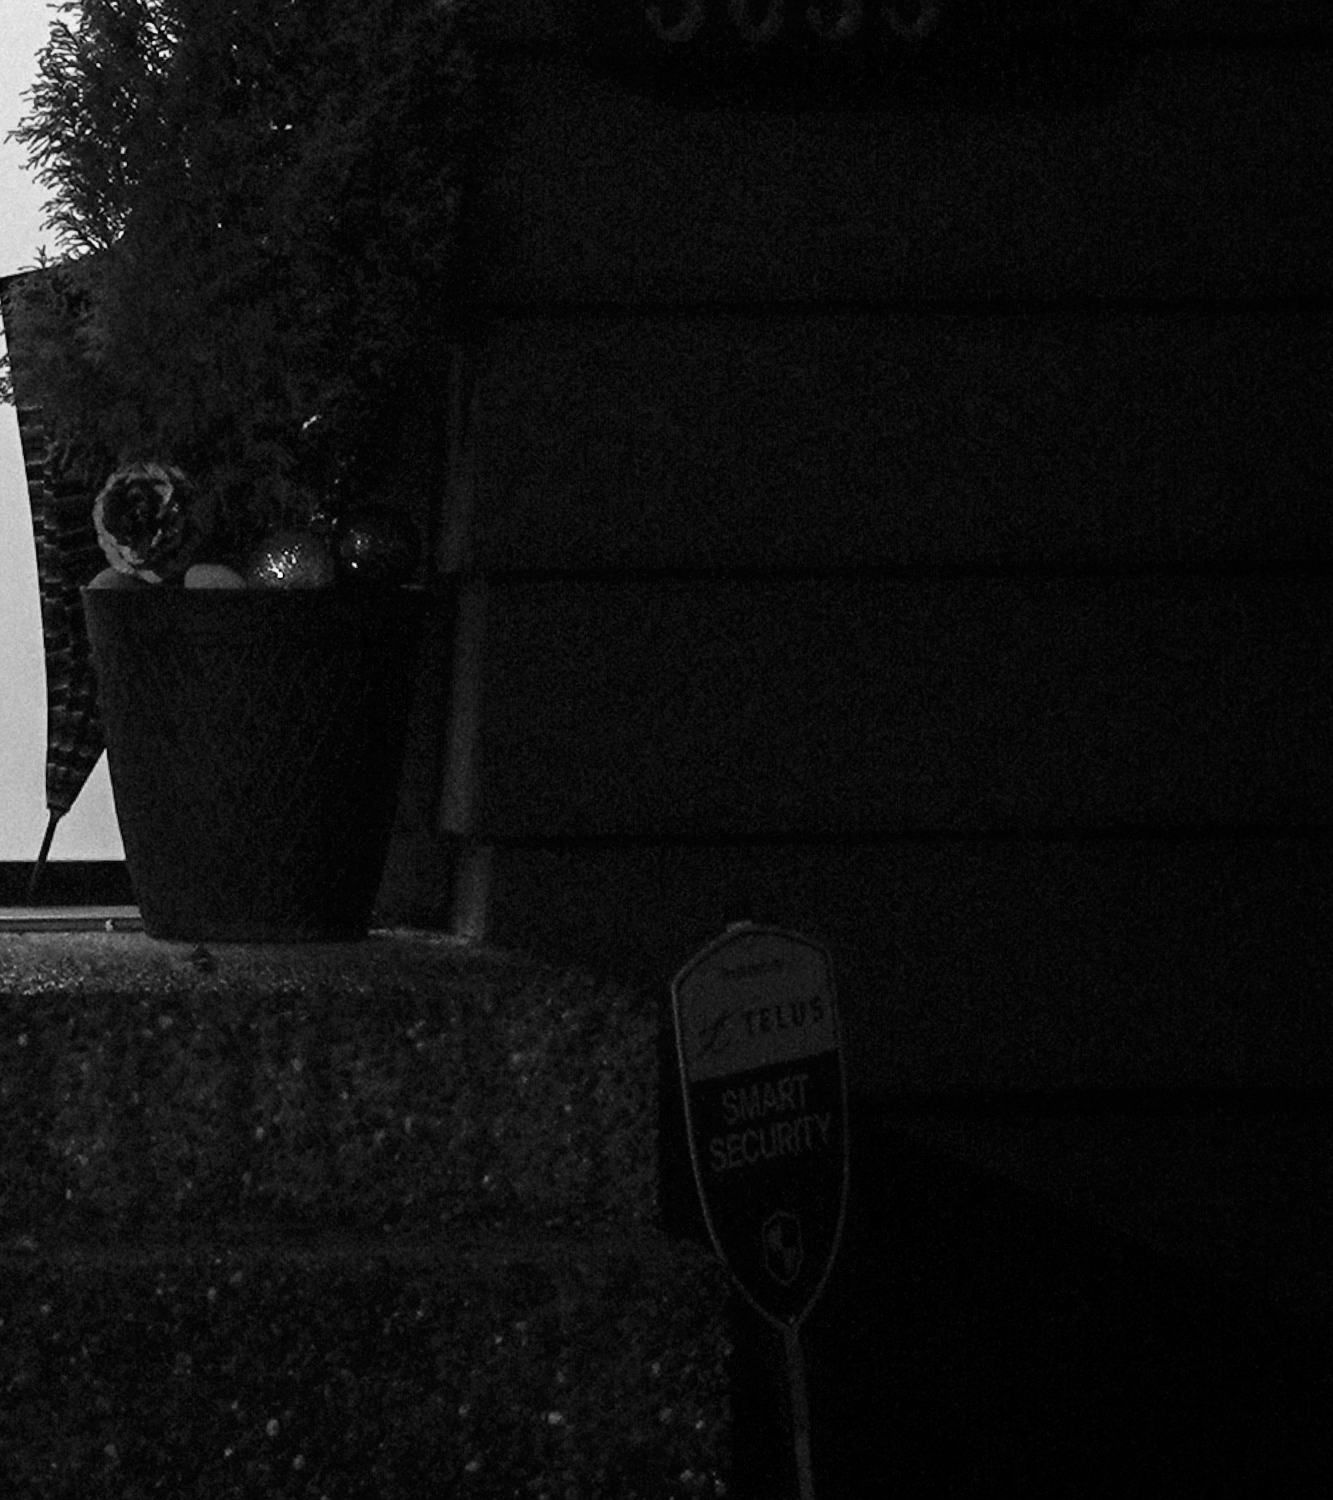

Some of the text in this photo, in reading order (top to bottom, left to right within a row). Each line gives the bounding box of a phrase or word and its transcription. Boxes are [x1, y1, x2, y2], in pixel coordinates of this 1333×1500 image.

[742, 998, 825, 1037] TELUS
[721, 1074, 810, 1125] SMART
[709, 1113, 831, 1172] SECURITY
